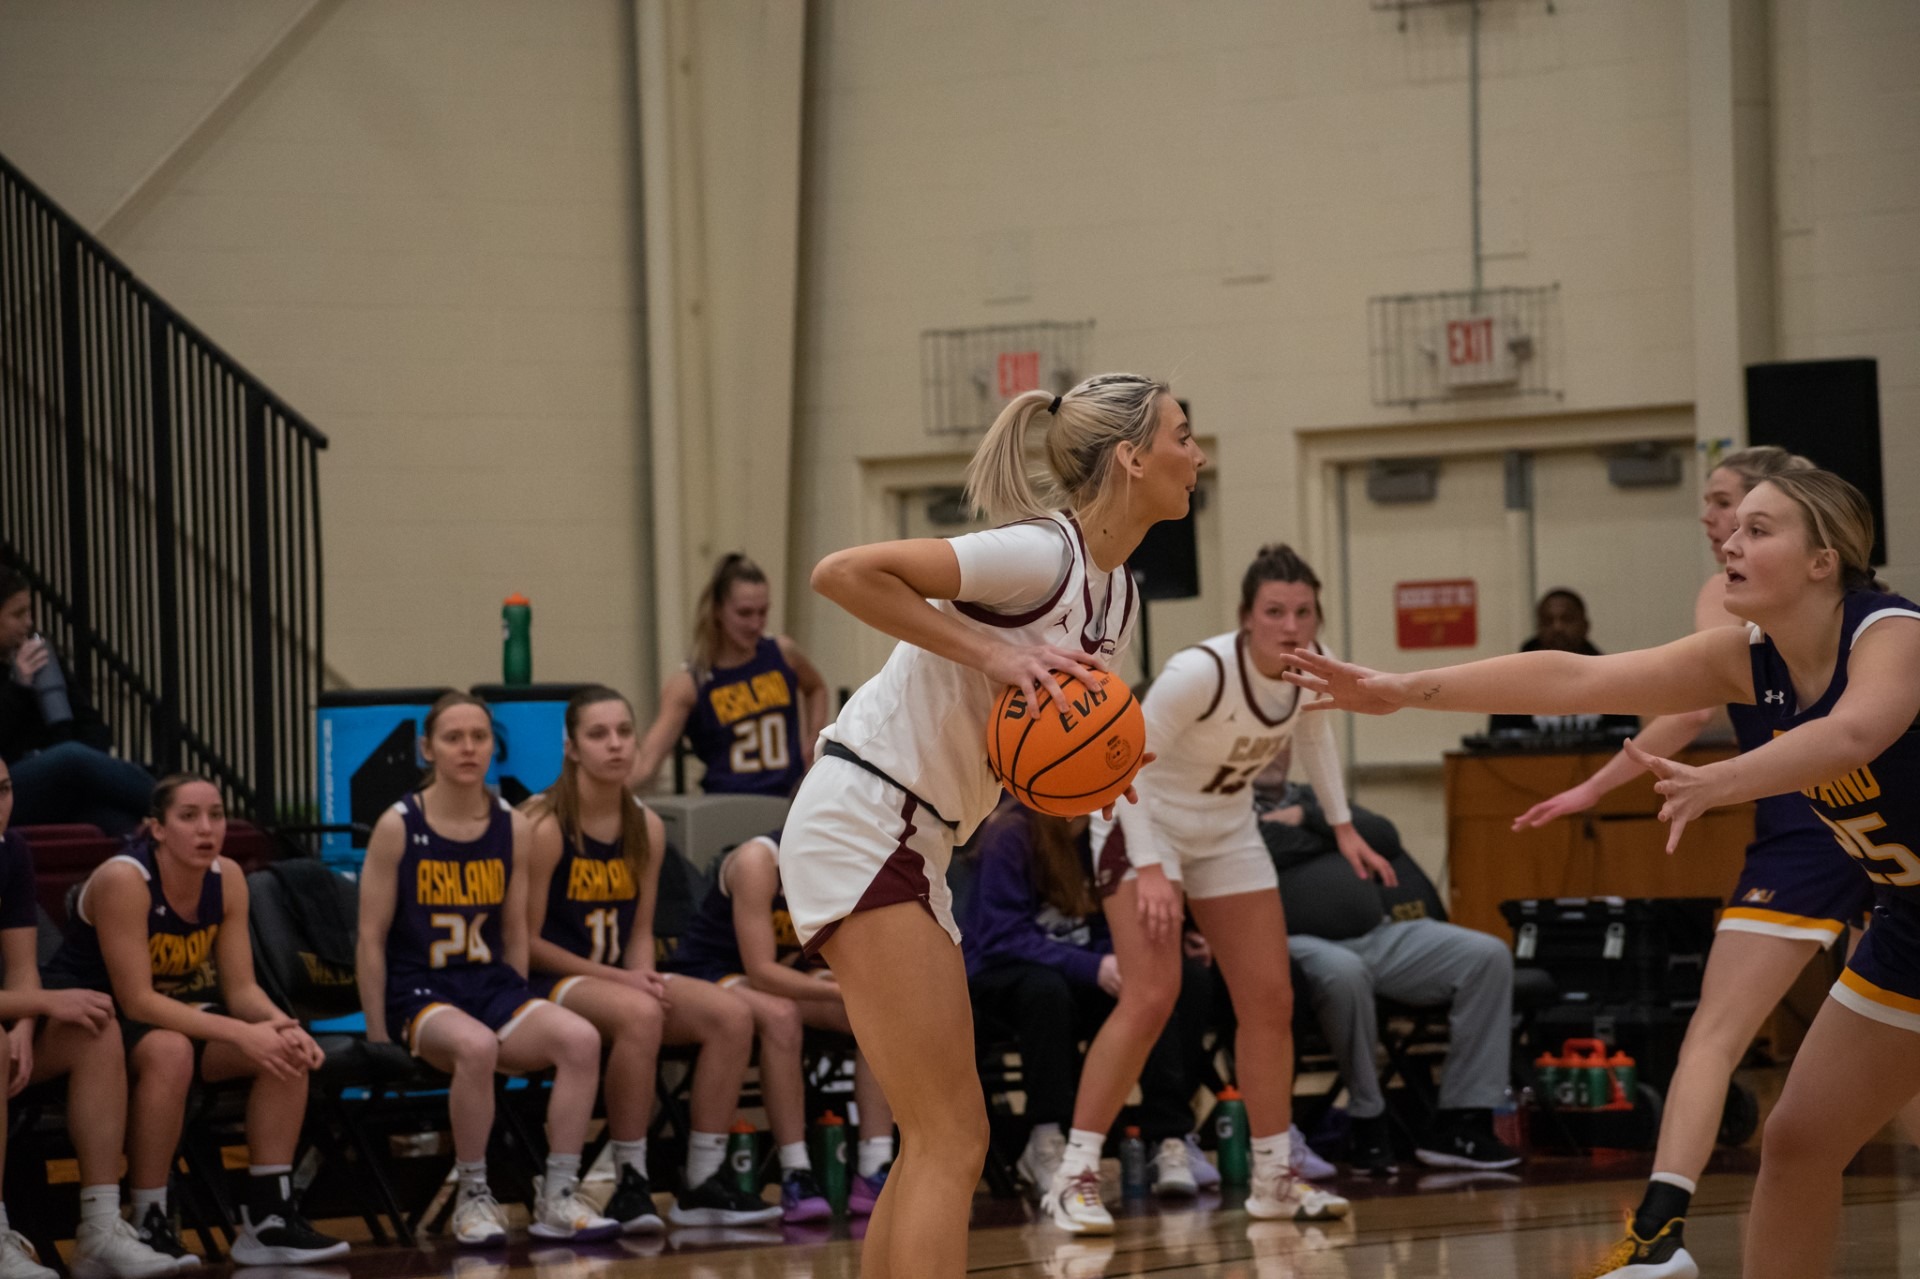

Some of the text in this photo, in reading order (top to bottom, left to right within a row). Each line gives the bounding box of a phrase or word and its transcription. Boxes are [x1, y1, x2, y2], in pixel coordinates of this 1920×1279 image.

[1447, 319, 1492, 366] EXIT
[998, 352, 1039, 398] EXIT
[710, 670, 791, 726] ASHLAND
[730, 713, 789, 773] 20
[417, 858, 505, 906] ASHLAND
[430, 912, 492, 969] 24
[585, 907, 620, 965] 11
[1216, 1116, 1233, 1138] G
[732, 1150, 752, 1173] G
